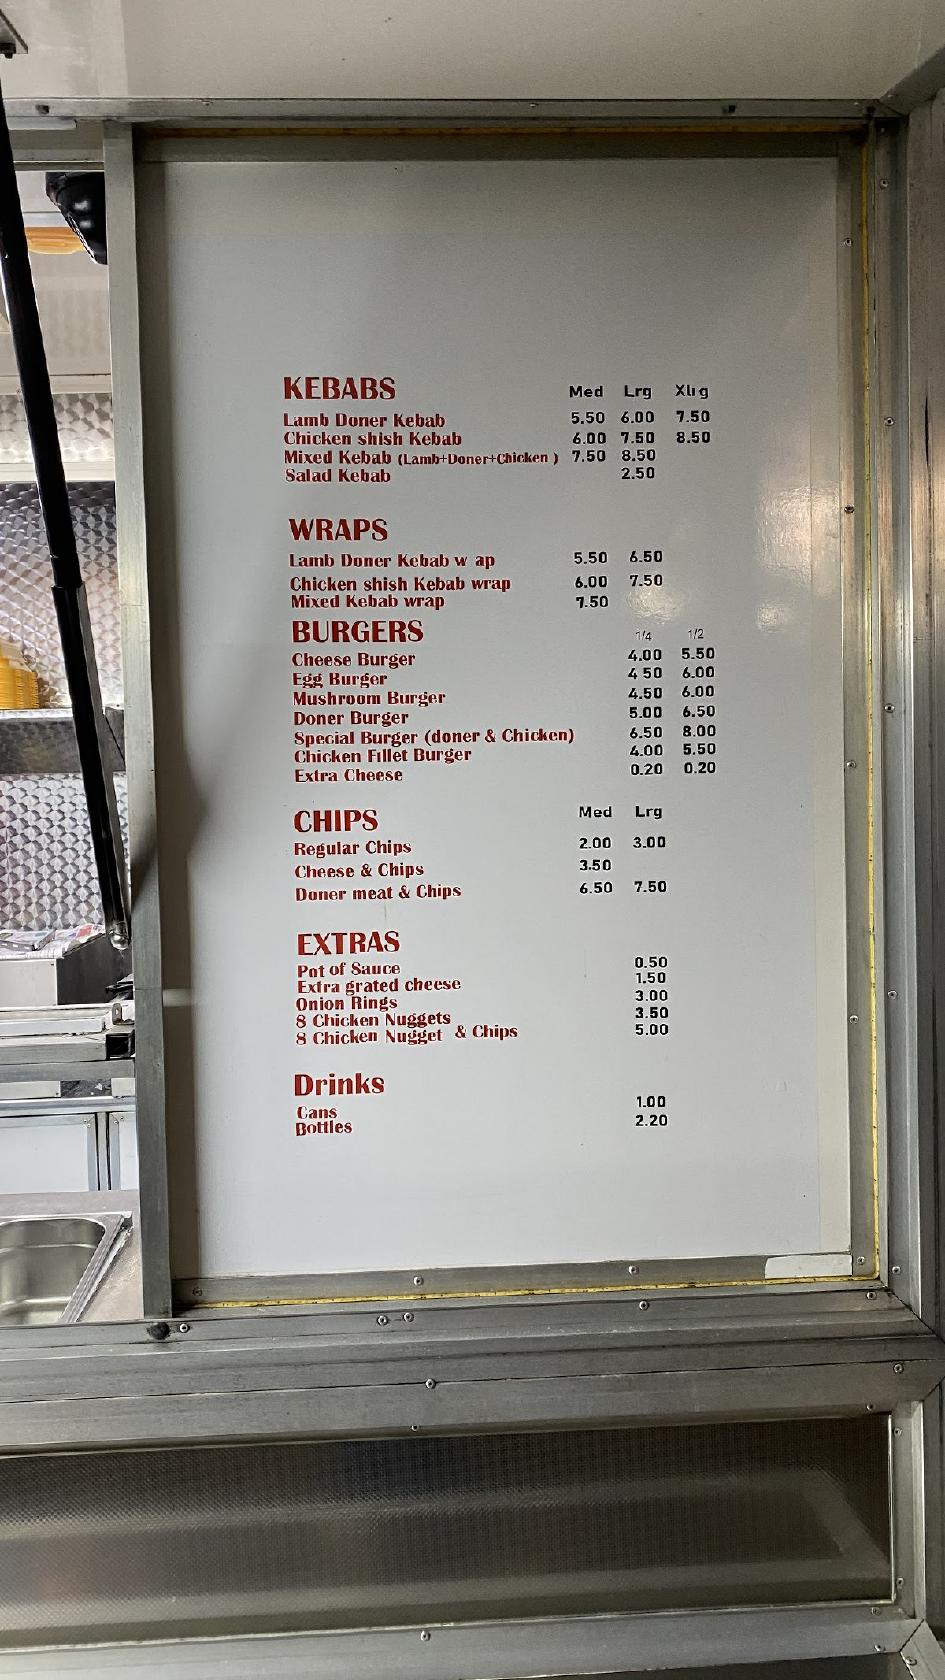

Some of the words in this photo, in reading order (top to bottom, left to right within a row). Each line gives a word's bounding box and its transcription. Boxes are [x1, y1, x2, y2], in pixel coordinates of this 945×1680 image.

[284, 377, 395, 399] KEBABS
[570, 386, 603, 398] Med
[624, 385, 651, 399] Lrg
[284, 413, 329, 426] Lamb
[336, 413, 387, 427] Doner
[394, 414, 445, 427] Kebab
[572, 412, 605, 424] 5.50
[621, 411, 654, 423] 6.00
[676, 410, 710, 422] 7.50
[284, 431, 351, 445] Chicken
[358, 432, 402, 445] shish
[410, 432, 461, 446] Kebab
[573, 432, 606, 444] 6.00
[621, 432, 654, 444] 7.50
[677, 432, 710, 443] 8.50
[285, 450, 332, 464] Mixed
[339, 450, 391, 465] Kebab
[572, 450, 606, 462] 7.50
[622, 449, 655, 461] 8.50
[286, 469, 331, 482] Salad
[339, 469, 390, 482] Kebab
[621, 467, 654, 479] 2.50
[289, 519, 388, 541] WRAPS
[290, 554, 334, 567] Lamb
[341, 554, 391, 567] Doner
[398, 554, 449, 567] Kebab
[574, 552, 607, 564] 5.50
[630, 551, 662, 562] 6.50
[290, 577, 357, 591] Chicken
[364, 577, 407, 591] shish
[414, 577, 465, 591] Kebab
[471, 580, 510, 592] wrap
[575, 576, 607, 588] 6.00
[630, 574, 662, 587] 7.50
[292, 595, 339, 608] Mixed
[346, 594, 398, 607] Kebab
[404, 597, 444, 610] wrap
[576, 596, 608, 608] 7.50
[293, 620, 423, 643] BURGERS
[636, 630, 652, 641] 1/4
[688, 629, 703, 639] 1/2
[292, 653, 351, 666] Cheese
[358, 653, 415, 669] Burger
[628, 649, 662, 661] 4.00
[682, 647, 714, 659] 5.50
[293, 673, 323, 688] Egg
[329, 673, 387, 688] Burger
[683, 666, 714, 678] 6.00
[294, 692, 381, 705] Mushroom
[388, 691, 445, 707] Burger
[628, 687, 662, 699] 4.50
[682, 685, 714, 697] 6.00
[294, 712, 344, 725] Doner
[351, 711, 409, 727] Burger
[630, 706, 662, 718] 5.00
[683, 705, 715, 717] 6.50
[295, 731, 354, 748] Special
[361, 732, 418, 747] Burger
[425, 729, 480, 746] (doner
[485, 729, 496, 743] &
[502, 728, 574, 744] Chicken)
[630, 727, 662, 739] 6.50
[683, 725, 716, 737] 8.00
[295, 750, 361, 763] Chicken
[368, 749, 408, 762] Fillet
[414, 748, 471, 764] Burger
[630, 744, 662, 756] 4.00
[683, 743, 716, 755] 5.50
[295, 769, 338, 782] Extra
[344, 769, 402, 781] Cheese
[631, 763, 662, 775] 0.20
[684, 762, 715, 774] 0.20
[294, 810, 378, 832] CHIPS
[579, 806, 612, 818] Med
[636, 806, 662, 819] Lrg
[294, 842, 359, 858] Regular
[366, 840, 411, 856] Chips
[579, 837, 611, 849] 2.00
[633, 836, 665, 848] 3.00
[295, 865, 354, 878] Cheese
[361, 864, 372, 877] &
[378, 862, 424, 878] Chips
[580, 859, 611, 871] 3.50
[296, 888, 346, 901] Doner
[353, 887, 393, 900] meat
[399, 885, 410, 899] &
[417, 884, 461, 900] Chips
[580, 882, 612, 894] 6.50
[634, 881, 666, 892] 7.50
[298, 931, 400, 955] EXTRAS
[298, 965, 325, 978] Pot
[329, 962, 346, 975] of
[351, 962, 400, 975] Sauce
[635, 956, 667, 968] 0.50
[298, 981, 340, 993] Extra
[346, 978, 398, 997] grated
[405, 977, 461, 991] cheese
[636, 972, 666, 984] 1.50
[296, 997, 344, 1011] Onion
[351, 996, 397, 1012] Rings
[635, 990, 668, 1001] 3.00
[296, 1015, 306, 1028] 8
[313, 1014, 379, 1027] Chicken
[386, 1011, 451, 1028] Nuggets
[635, 1007, 668, 1018] 3.50
[296, 1032, 306, 1045] 8
[313, 1029, 377, 1044] Chicken
[386, 1029, 442, 1045] Nugget
[455, 1025, 466, 1038] &
[473, 1025, 517, 1040] Chips
[636, 1024, 668, 1035] 5.00
[295, 1073, 384, 1096] Drinks
[297, 1106, 337, 1121] Cans
[637, 1096, 665, 1107] 1.00
[296, 1120, 352, 1136] Bottles
[636, 1114, 667, 1126] 2.20
